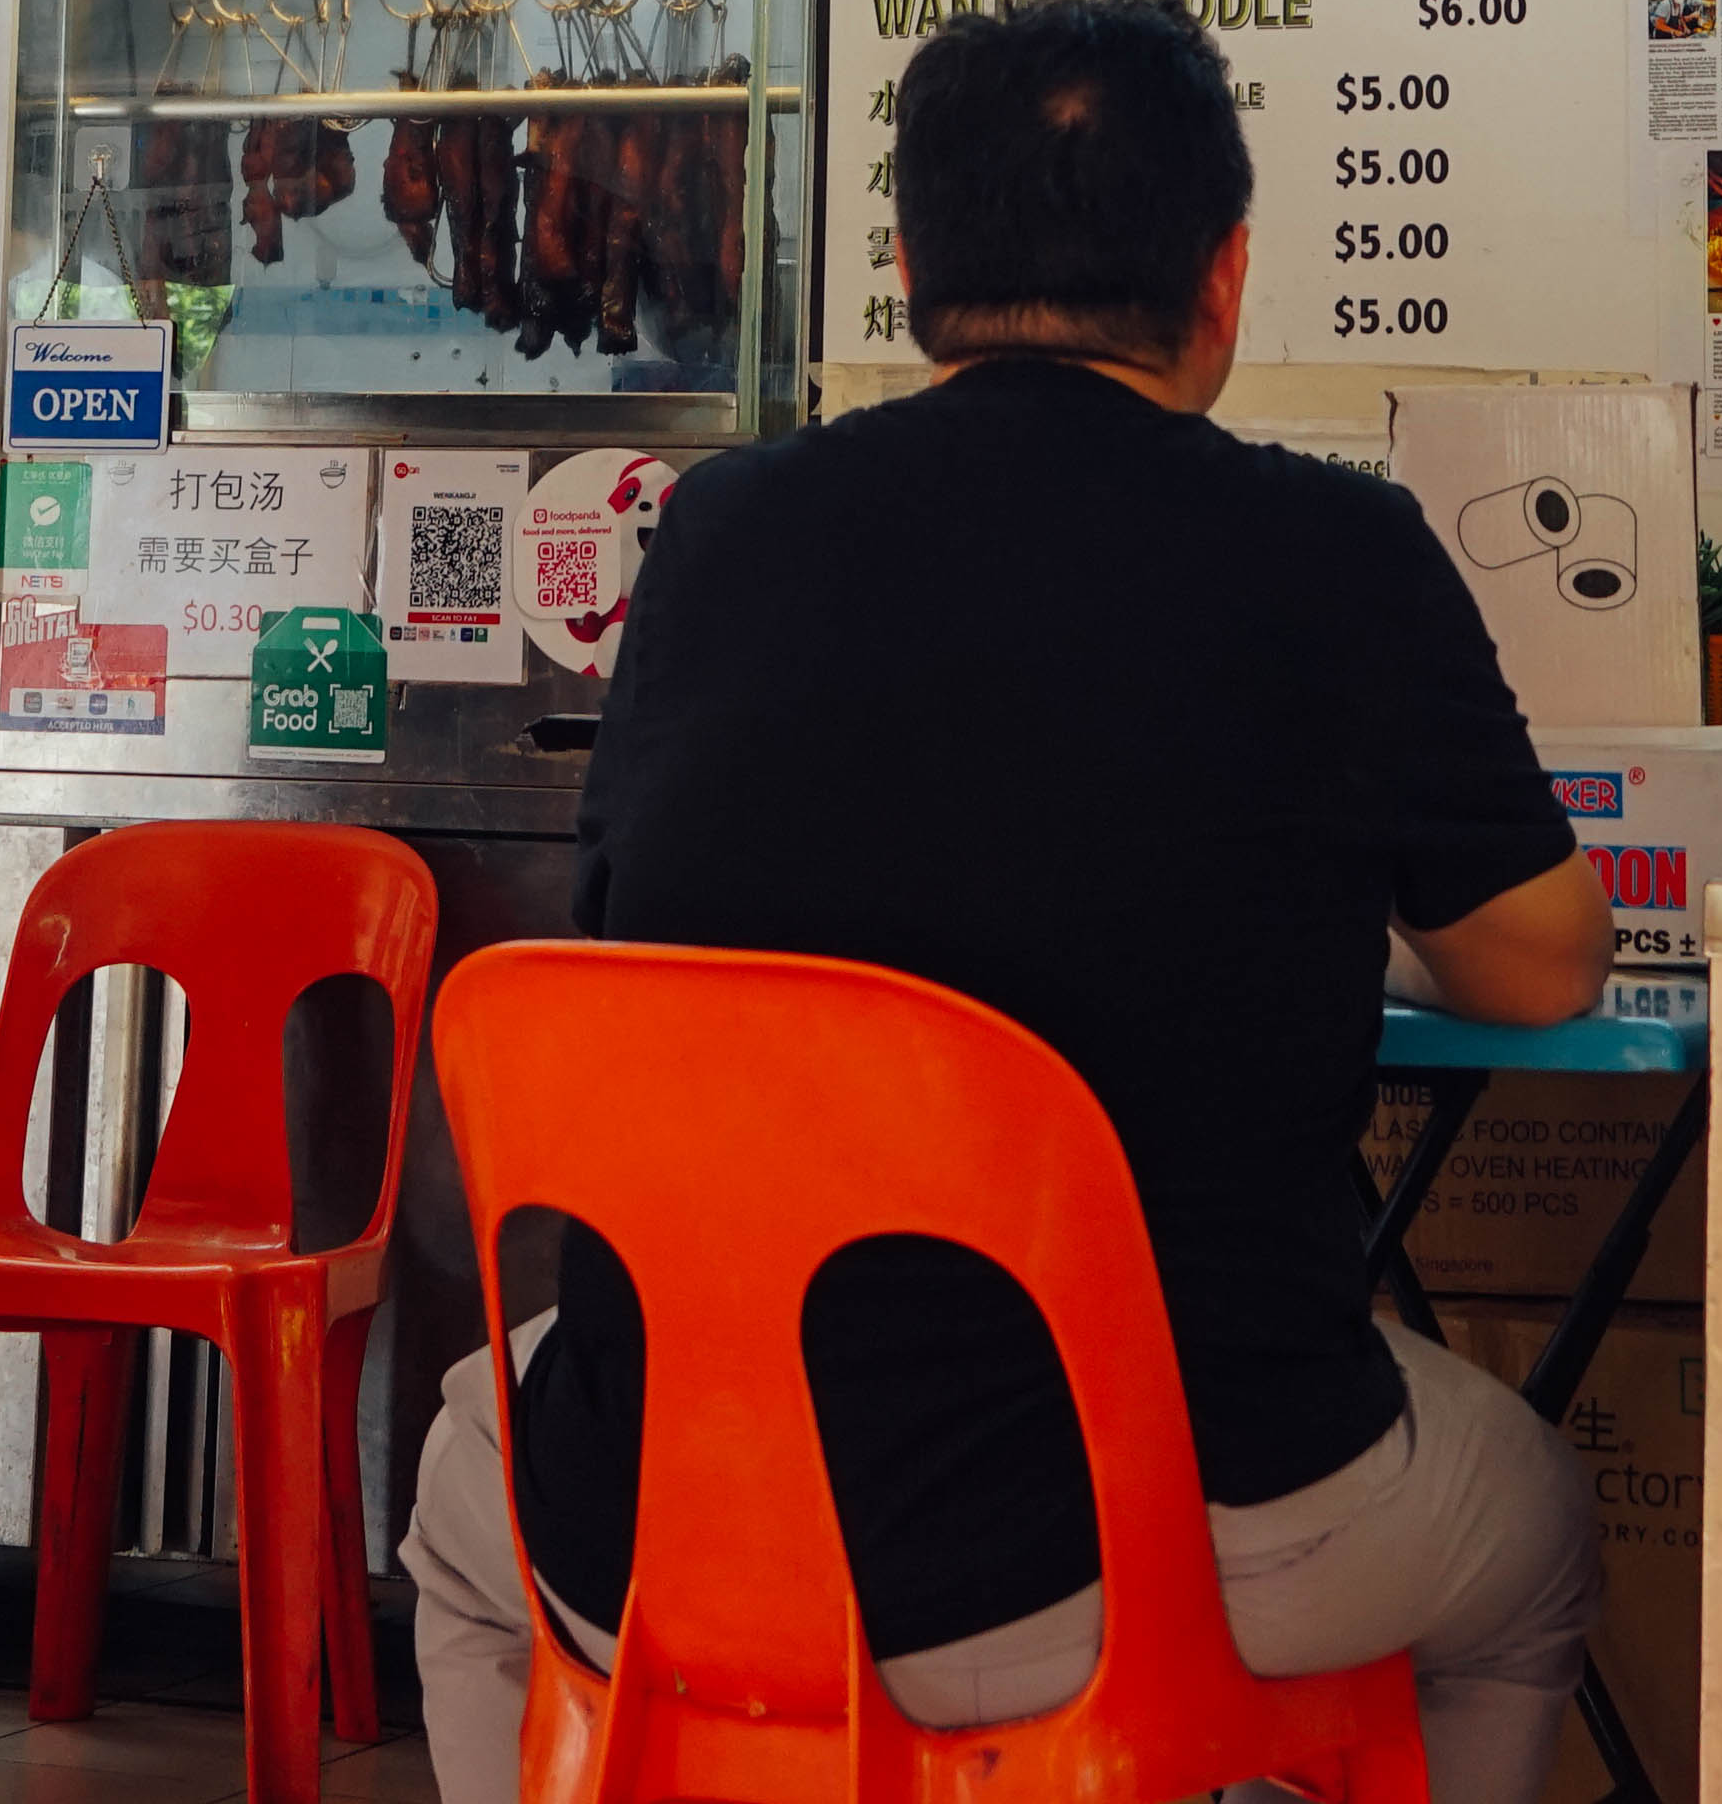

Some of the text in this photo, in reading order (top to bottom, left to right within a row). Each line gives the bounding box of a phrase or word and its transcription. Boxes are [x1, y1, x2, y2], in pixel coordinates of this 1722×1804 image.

[1336, 73, 1450, 114] $5.00
[1336, 148, 1450, 189] $5.00
[1335, 222, 1449, 264] $5.00
[1335, 298, 1449, 338] $5.00
[24, 341, 113, 366] Welcome
[32, 387, 138, 423] OPEN
[169, 469, 284, 512] 打包汤
[550, 509, 600, 523] foodpanda
[523, 527, 539, 537] food
[541, 527, 555, 536] and
[578, 526, 611, 536] delivered
[137, 536, 314, 577] 需要买盒子
[21, 575, 63, 588] NETS
[7, 595, 36, 621] GO
[183, 599, 263, 634] $0.30
[432, 614, 477, 623] SCAN TO PAY
[4, 609, 78, 647] DIGITAL
[263, 684, 319, 707] Grab
[263, 709, 317, 731] Food
[1615, 928, 1671, 955] PCS
[1474, 1121, 1549, 1142] FOOD
[1451, 1156, 1525, 1179] OVEN
[1472, 1193, 1515, 1215] 500
[1524, 1194, 1579, 1216] PCS
